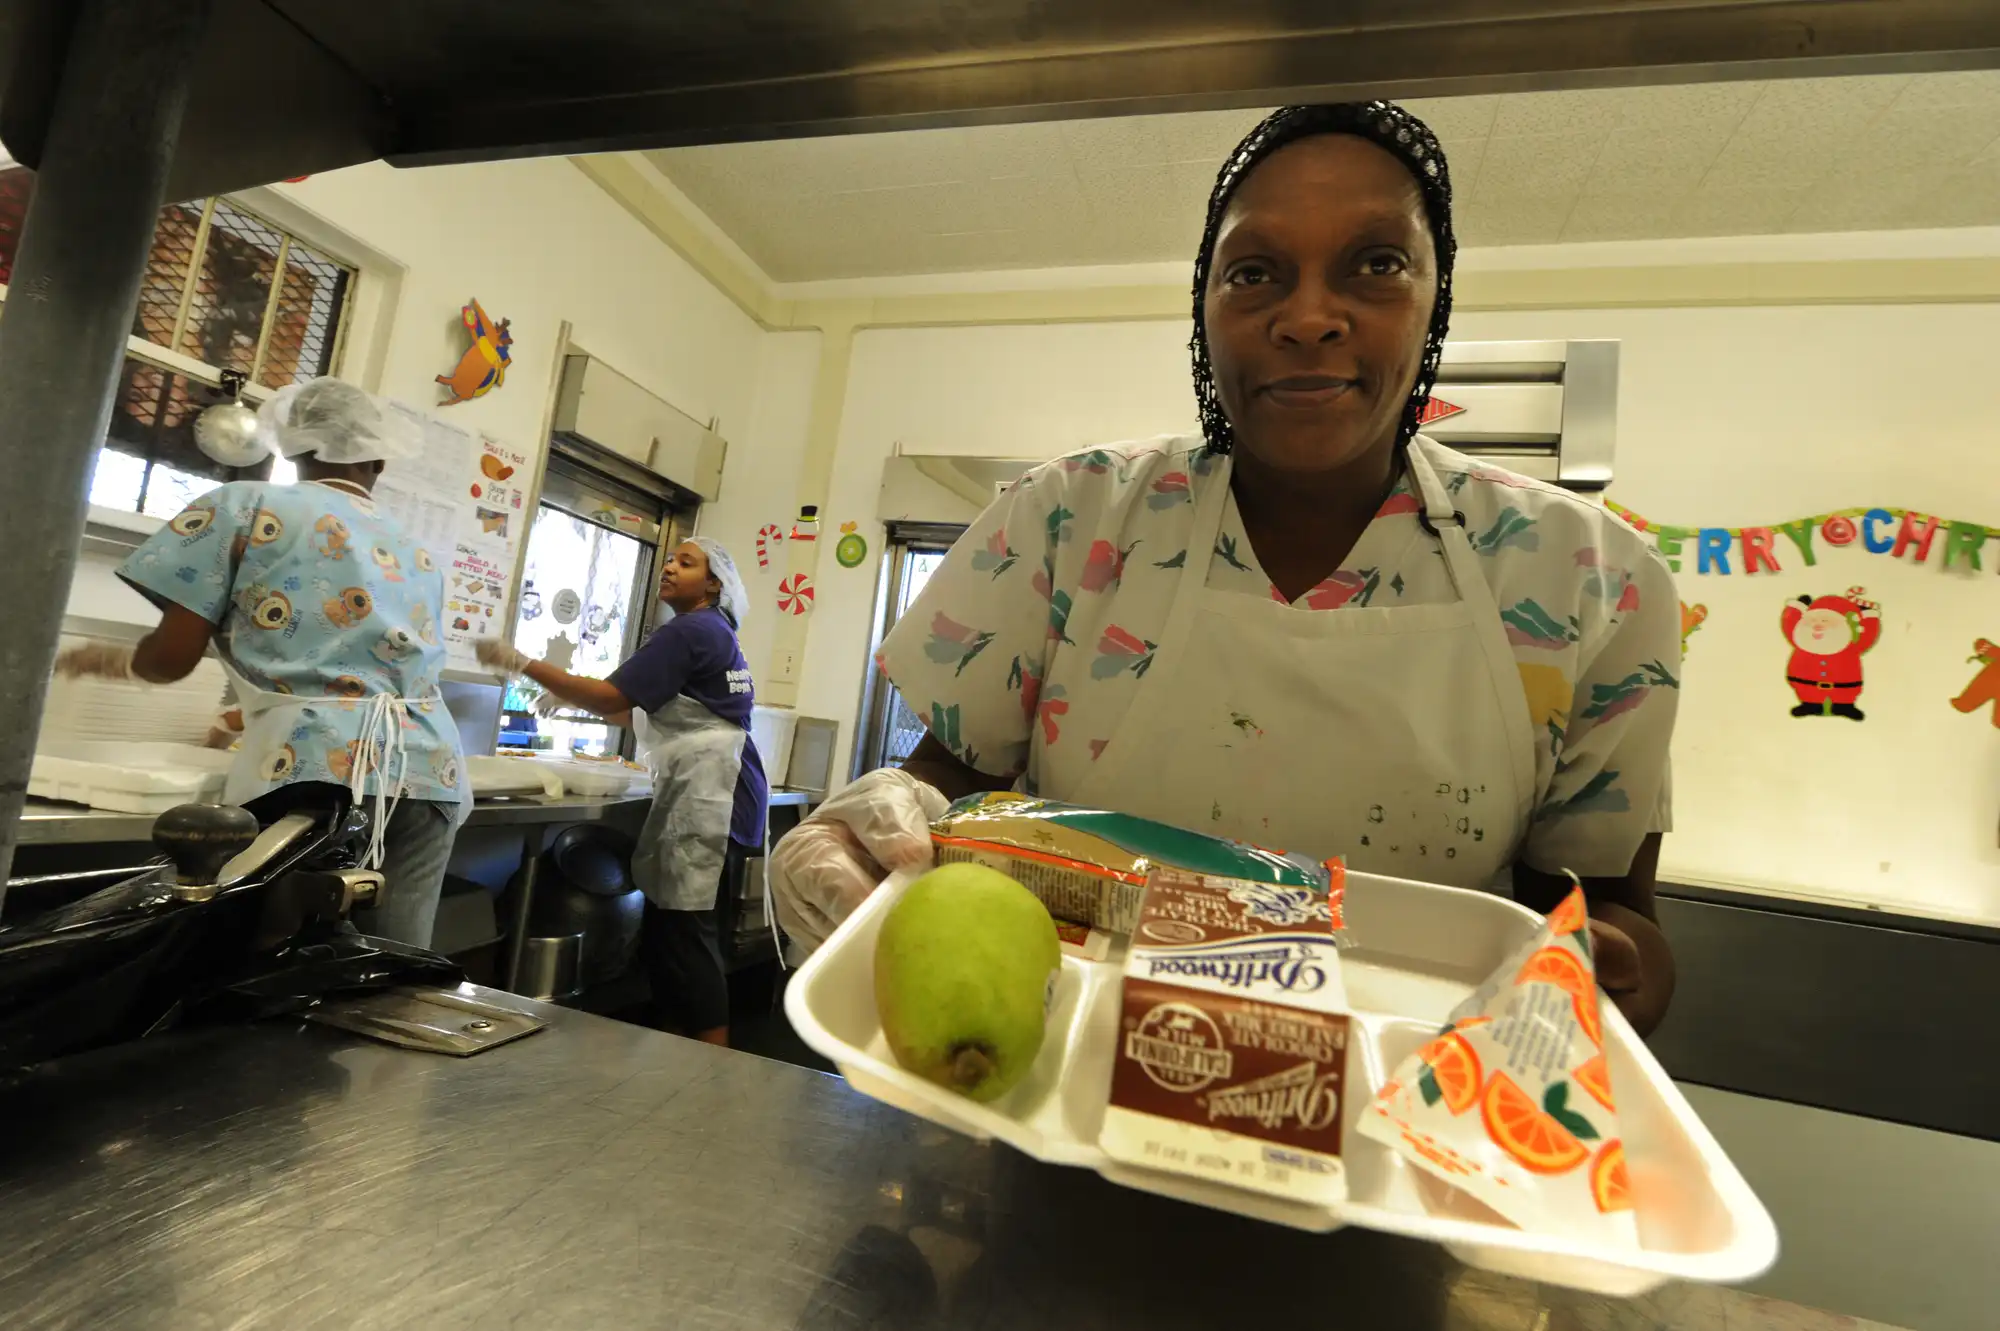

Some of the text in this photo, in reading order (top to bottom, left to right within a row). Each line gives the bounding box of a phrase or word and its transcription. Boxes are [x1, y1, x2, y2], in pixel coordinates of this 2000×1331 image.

[1620, 507, 2000, 576] ERRY CHR
[286, 607, 305, 639] WANTED
[1162, 901, 1248, 922] FAT FREE
[1184, 896, 1228, 912] MILK
[1146, 906, 1264, 933] CHOCOLATE
[1150, 955, 1326, 992] Driftwood
[1157, 1026, 1206, 1046] MILK
[1223, 1012, 1261, 1033] MILK
[1132, 1037, 1228, 1075] CALIFORNIA
[1229, 1029, 1333, 1063] CHOCOLATE
[1160, 1069, 1196, 1084] REAL
[1208, 1072, 1338, 1130] Driftwood
